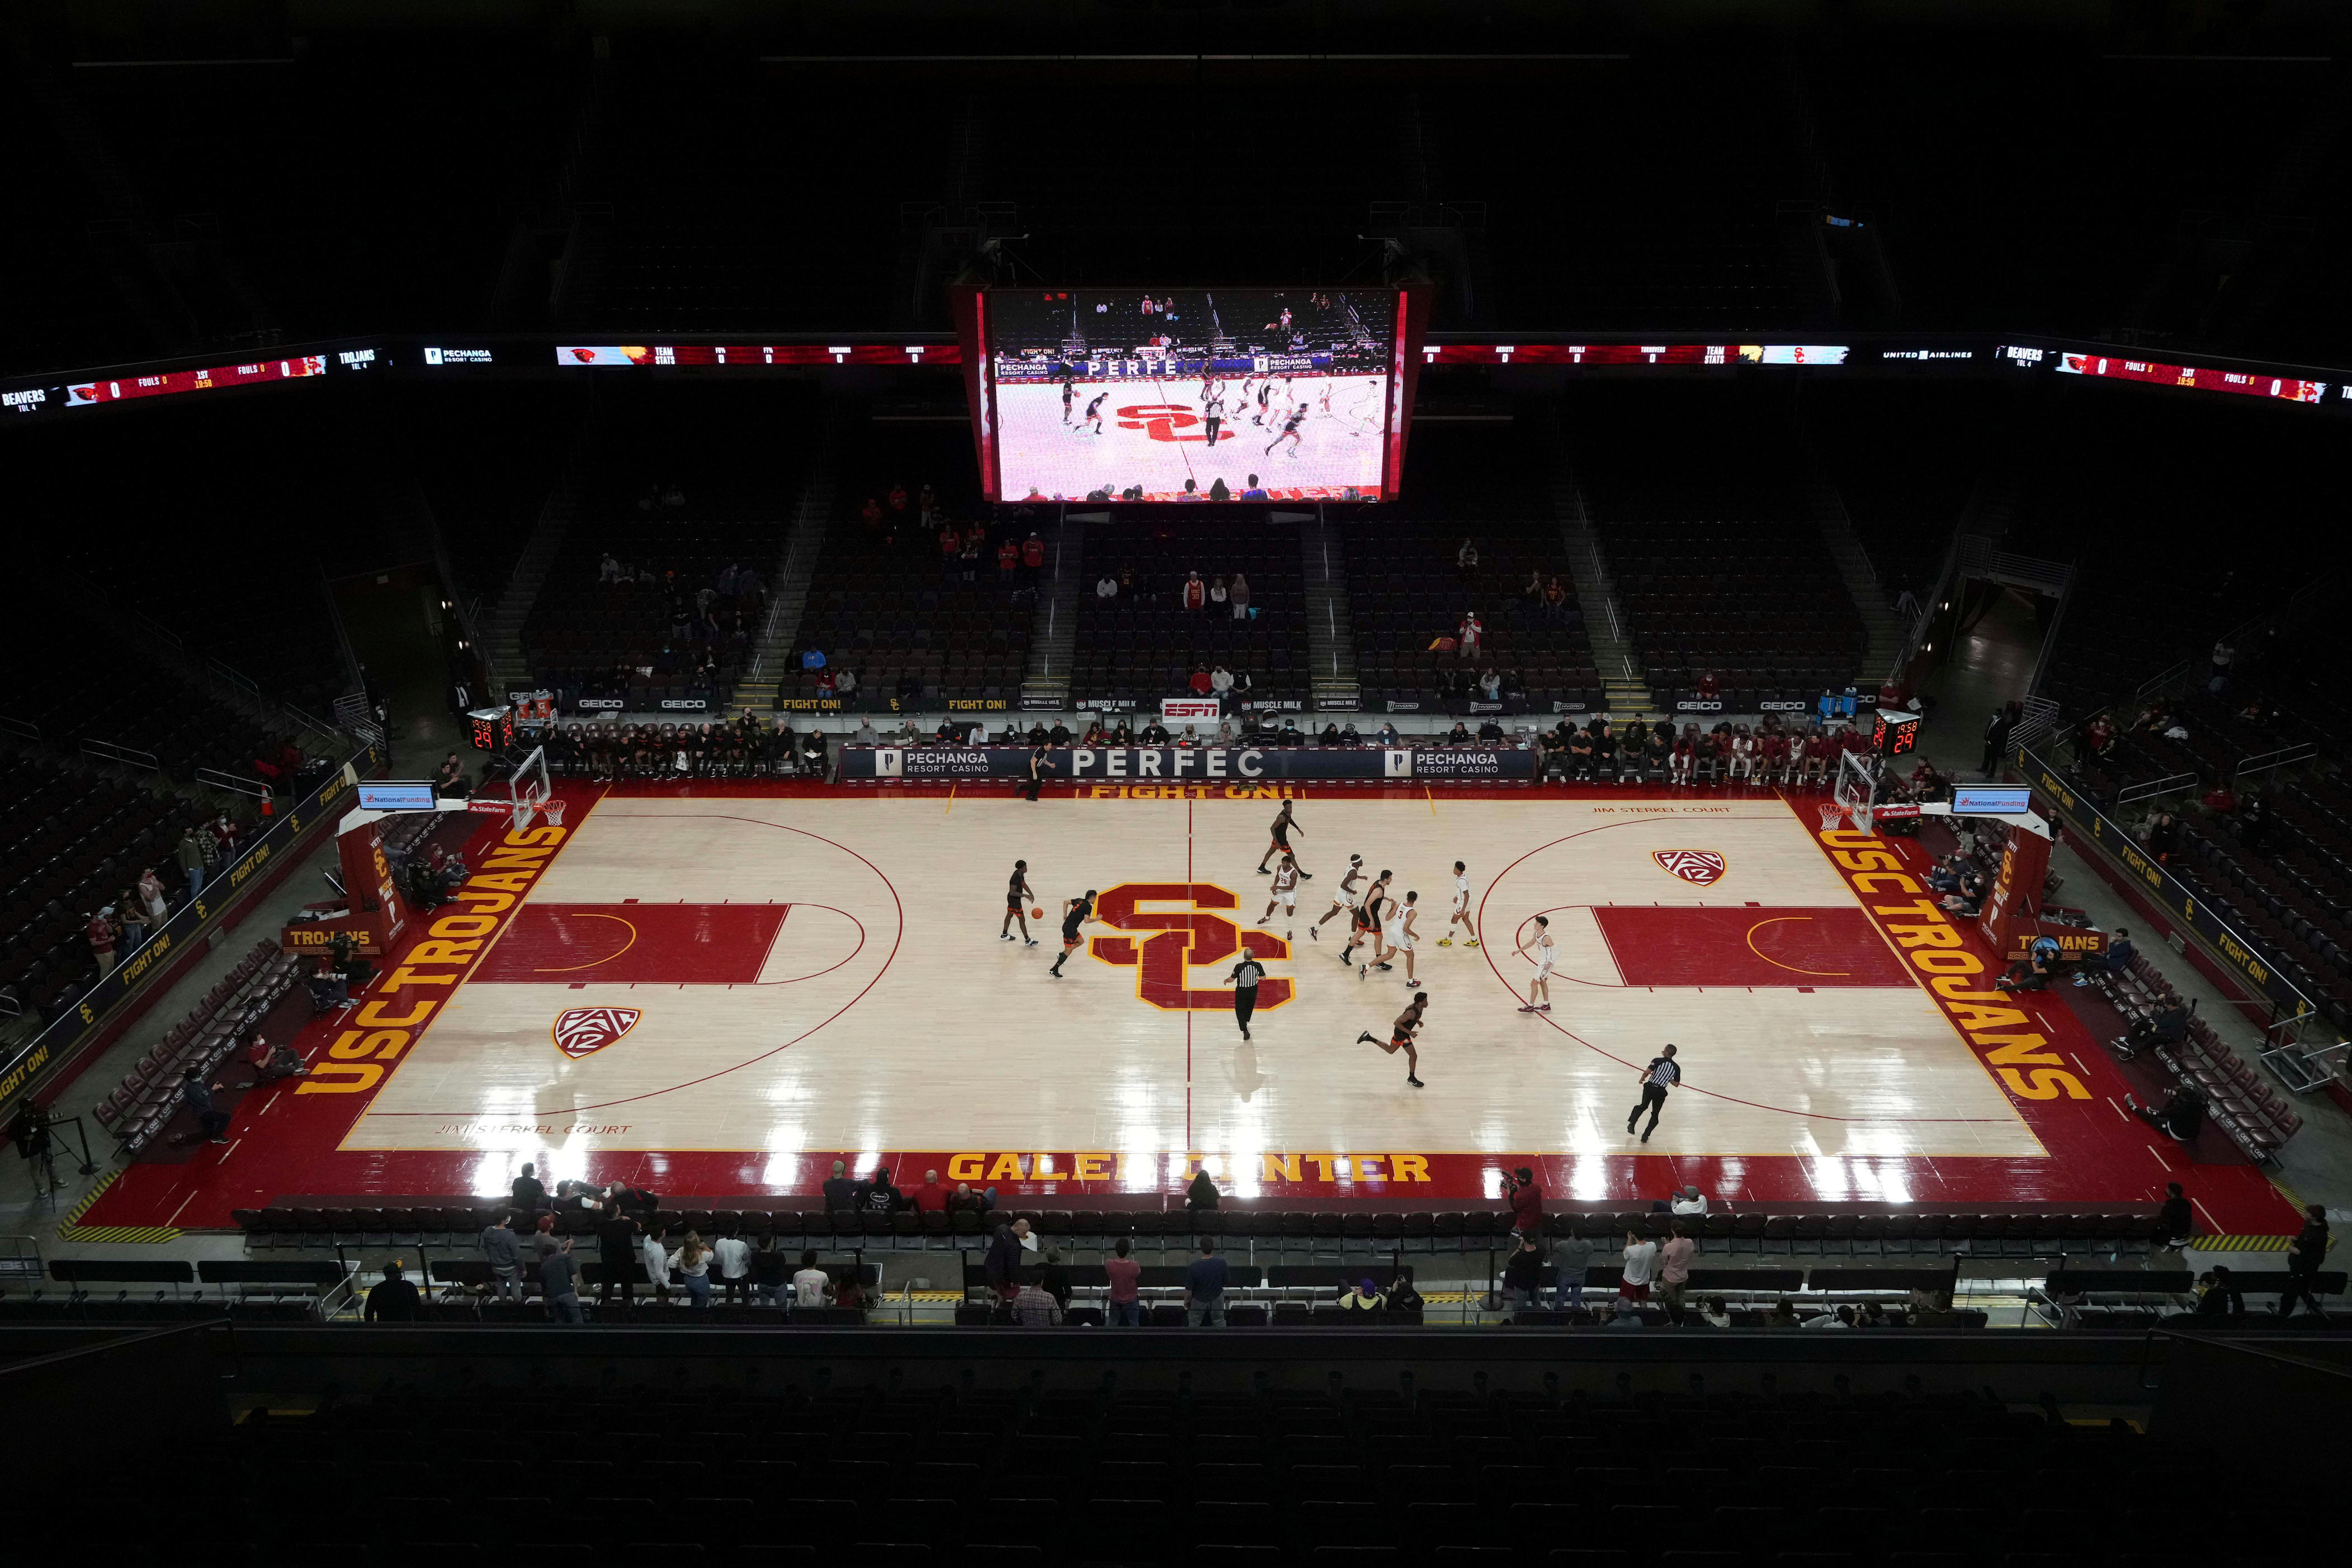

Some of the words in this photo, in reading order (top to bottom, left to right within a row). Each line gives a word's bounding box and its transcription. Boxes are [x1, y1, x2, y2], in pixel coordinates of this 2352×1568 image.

[655, 347, 673, 356] TEAM
[1706, 346, 1725, 355] TEAM
[2007, 346, 2043, 361] BEAVERS
[339, 350, 375, 364] TROJANS
[655, 356, 676, 365] STATS
[718, 354, 725, 364] 0
[765, 354, 772, 363] 0
[836, 354, 843, 363] 0
[911, 353, 919, 363] 0
[1427, 353, 1434, 363] 0
[1501, 353, 1509, 363] 0
[1574, 353, 1581, 363] 0
[1649, 353, 1656, 363] 0
[1704, 355, 1725, 364] STATS
[238, 365, 258, 375] FOULS
[260, 364, 265, 372] 0
[281, 361, 290, 377] 0
[2098, 358, 2108, 375] 0
[2125, 361, 2146, 372] FOULS
[2148, 364, 2153, 373] 0
[2182, 367, 2194, 377] 1ST
[196, 370, 209, 380] 1ST
[2225, 373, 2247, 384] FOULS
[2249, 376, 2255, 385] 0
[138, 376, 160, 387] FOULS
[162, 376, 167, 384] 0
[195, 379, 212, 389] 19:58
[2176, 376, 2195, 386] 19:58
[110, 382, 121, 398] 0
[2270, 379, 2282, 396] 0
[2, 389, 46, 407] BEAVERS
[29, 403, 36, 411] 4
[579, 700, 624, 708] GEICO
[661, 700, 706, 708] GEICO
[784, 700, 817, 709] FIGHT
[820, 700, 840, 709] ON!
[950, 700, 984, 709] FIGHT
[986, 700, 1006, 709] ON!
[1088, 700, 1116, 708] MUSCLE
[1253, 701, 1282, 709] MUSCLE
[1284, 701, 1301, 710] MILK
[1677, 701, 1722, 710] GEICO
[1760, 701, 1806, 710] GEICO
[1165, 703, 1218, 717] ESPN
[472, 719, 492, 732] 19:58
[1897, 721, 1918, 734] 19:58
[474, 730, 492, 748] 29
[1894, 733, 1913, 753] 29
[907, 753, 988, 764] PECHANGA
[1416, 754, 1498, 764] PECHANGA
[319, 781, 339, 806] FIGHT
[1090, 786, 1213, 799] FIGHT
[1225, 786, 1294, 799] ON!
[2042, 772, 2061, 802] FIGHT
[2058, 789, 2074, 810] ON!
[370, 836, 381, 849] YETI
[2007, 839, 2018, 853] YETI
[230, 859, 254, 887] FIGHT
[254, 844, 270, 865] ON!
[2122, 846, 2146, 876] FIGHT
[2144, 865, 2161, 887] ON!
[1684, 868, 1713, 879] 12
[1398, 910, 1403, 919] 3
[290, 931, 370, 944] TROJNS
[2019, 935, 2099, 950] TJANS
[122, 951, 153, 985] FIGHT
[152, 934, 171, 958] ON!
[294, 1000, 437, 1095] USC
[379, 826, 566, 993] TROJANS
[2219, 933, 2249, 967] FIGHT
[2246, 956, 2267, 984] ON!
[1819, 830, 1923, 893] USC
[1873, 899, 2093, 1100] TROJANS
[567, 1034, 604, 1049] 12
[27, 1045, 49, 1073] ON!
[564, 1125, 633, 1134] COURT
[1180, 1154, 1432, 1183] CNTER
